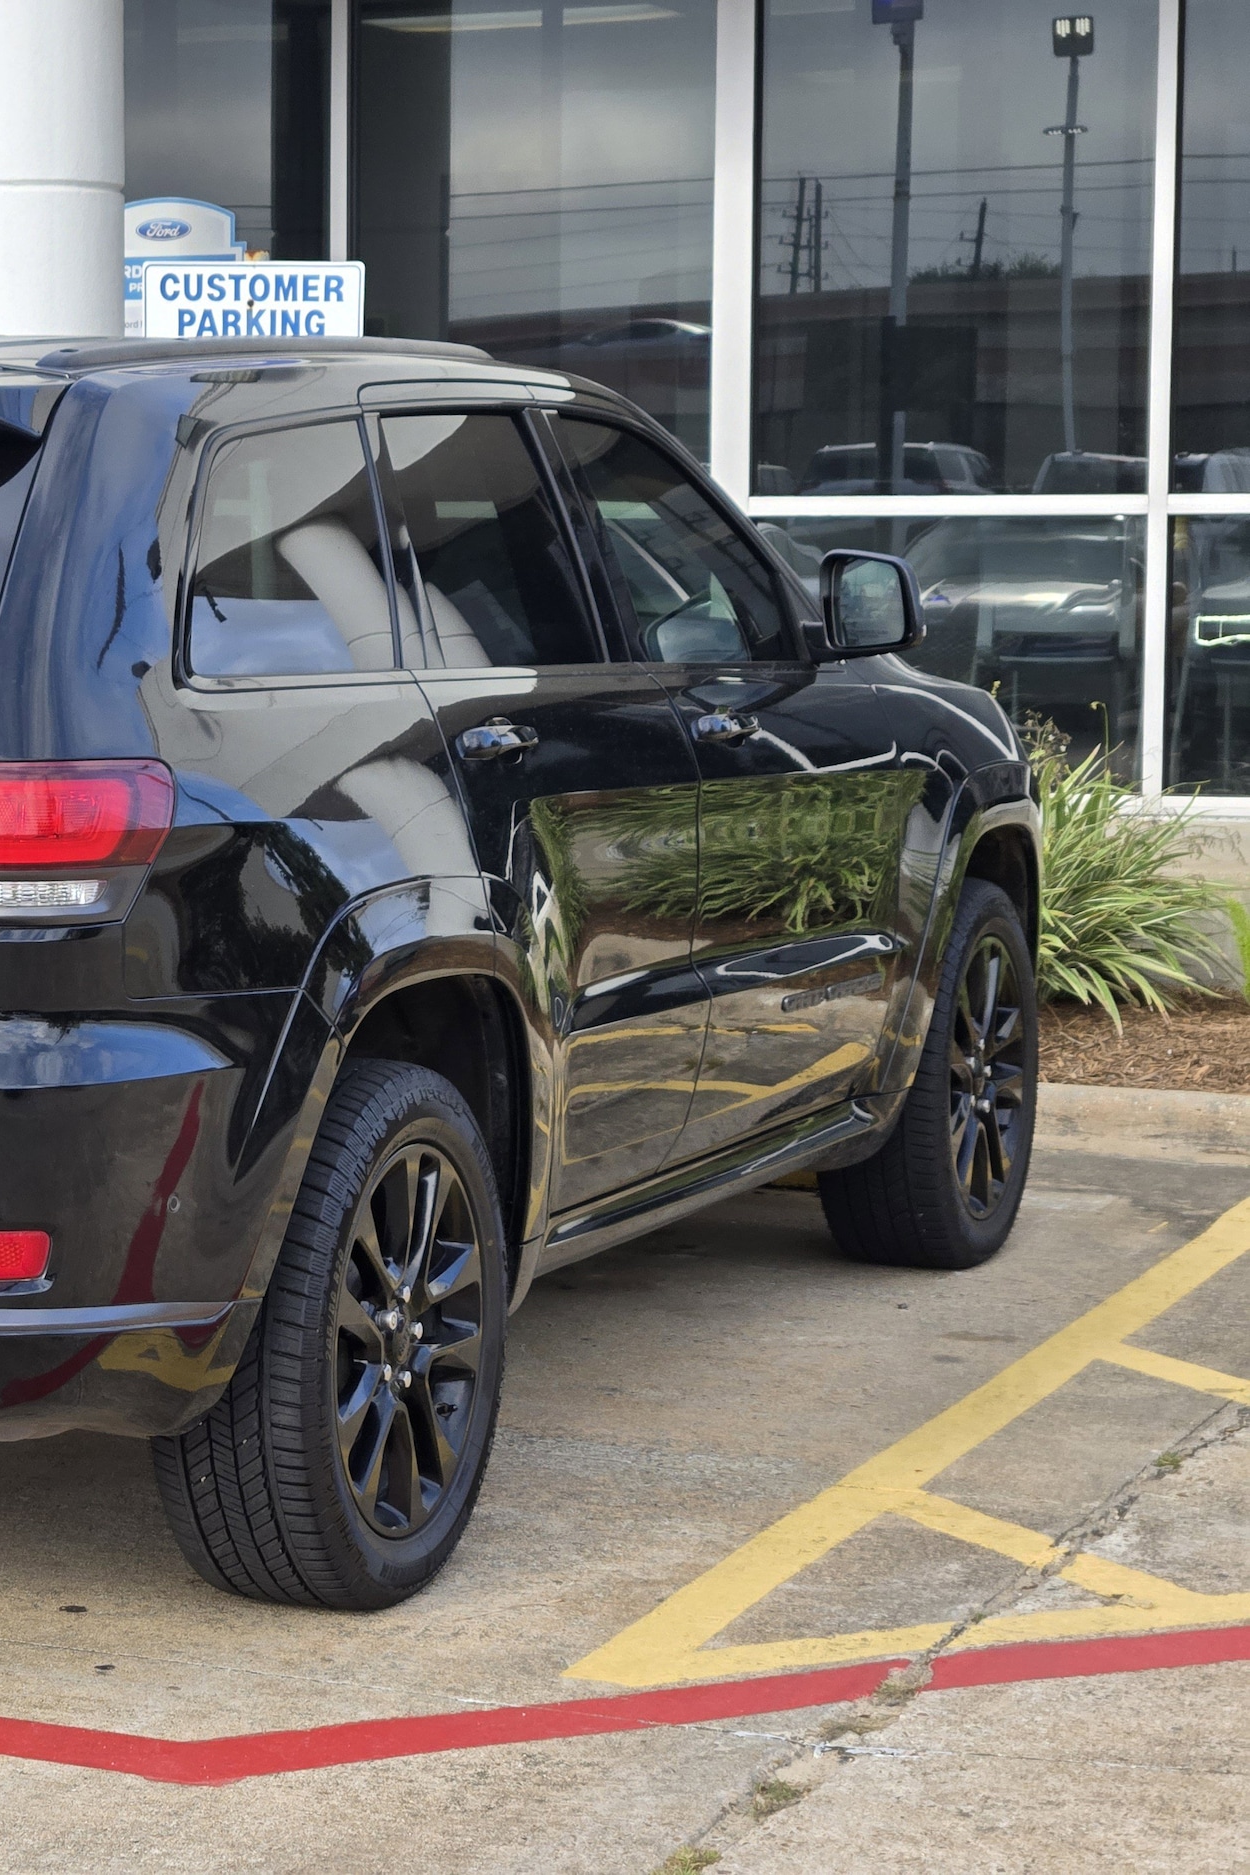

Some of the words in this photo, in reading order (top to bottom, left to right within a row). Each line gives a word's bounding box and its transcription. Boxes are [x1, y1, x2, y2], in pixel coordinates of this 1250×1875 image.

[146, 221, 181, 238] Ford
[124, 265, 143, 278] RD
[159, 273, 345, 302] CUSTOMER
[124, 321, 139, 329] ord
[178, 308, 326, 336] PARKING
